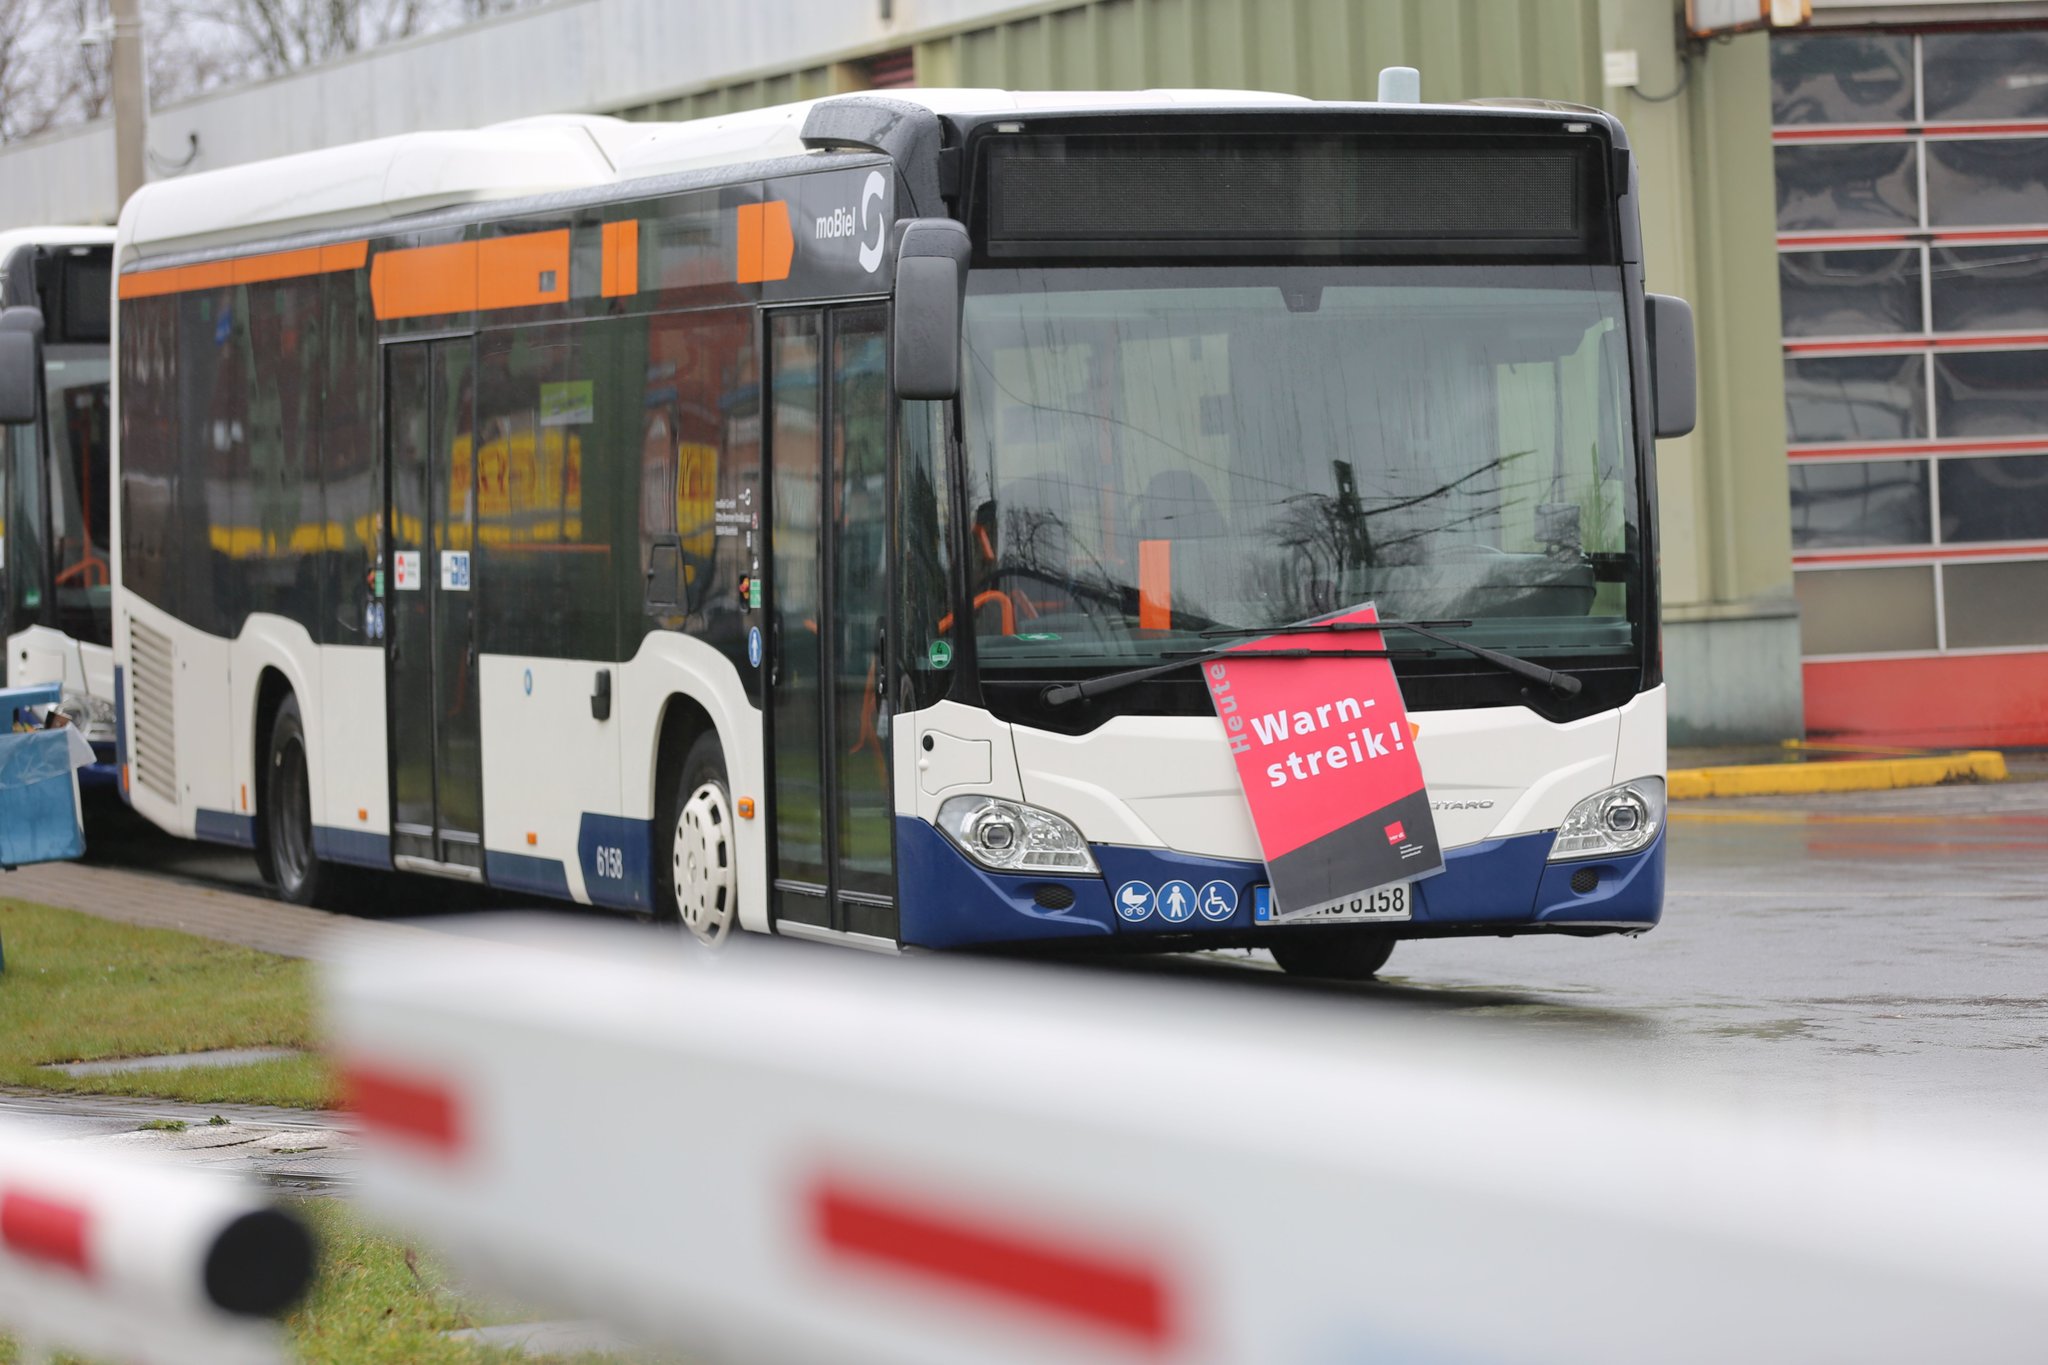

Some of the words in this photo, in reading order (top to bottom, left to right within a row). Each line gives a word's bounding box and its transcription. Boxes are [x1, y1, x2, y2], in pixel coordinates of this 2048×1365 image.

[816, 207, 856, 239] moBiel
[1210, 664, 1251, 754] Heute
[1250, 697, 1376, 746] Warn-
[1266, 721, 1404, 788] streik!
[597, 845, 623, 879] 6158
